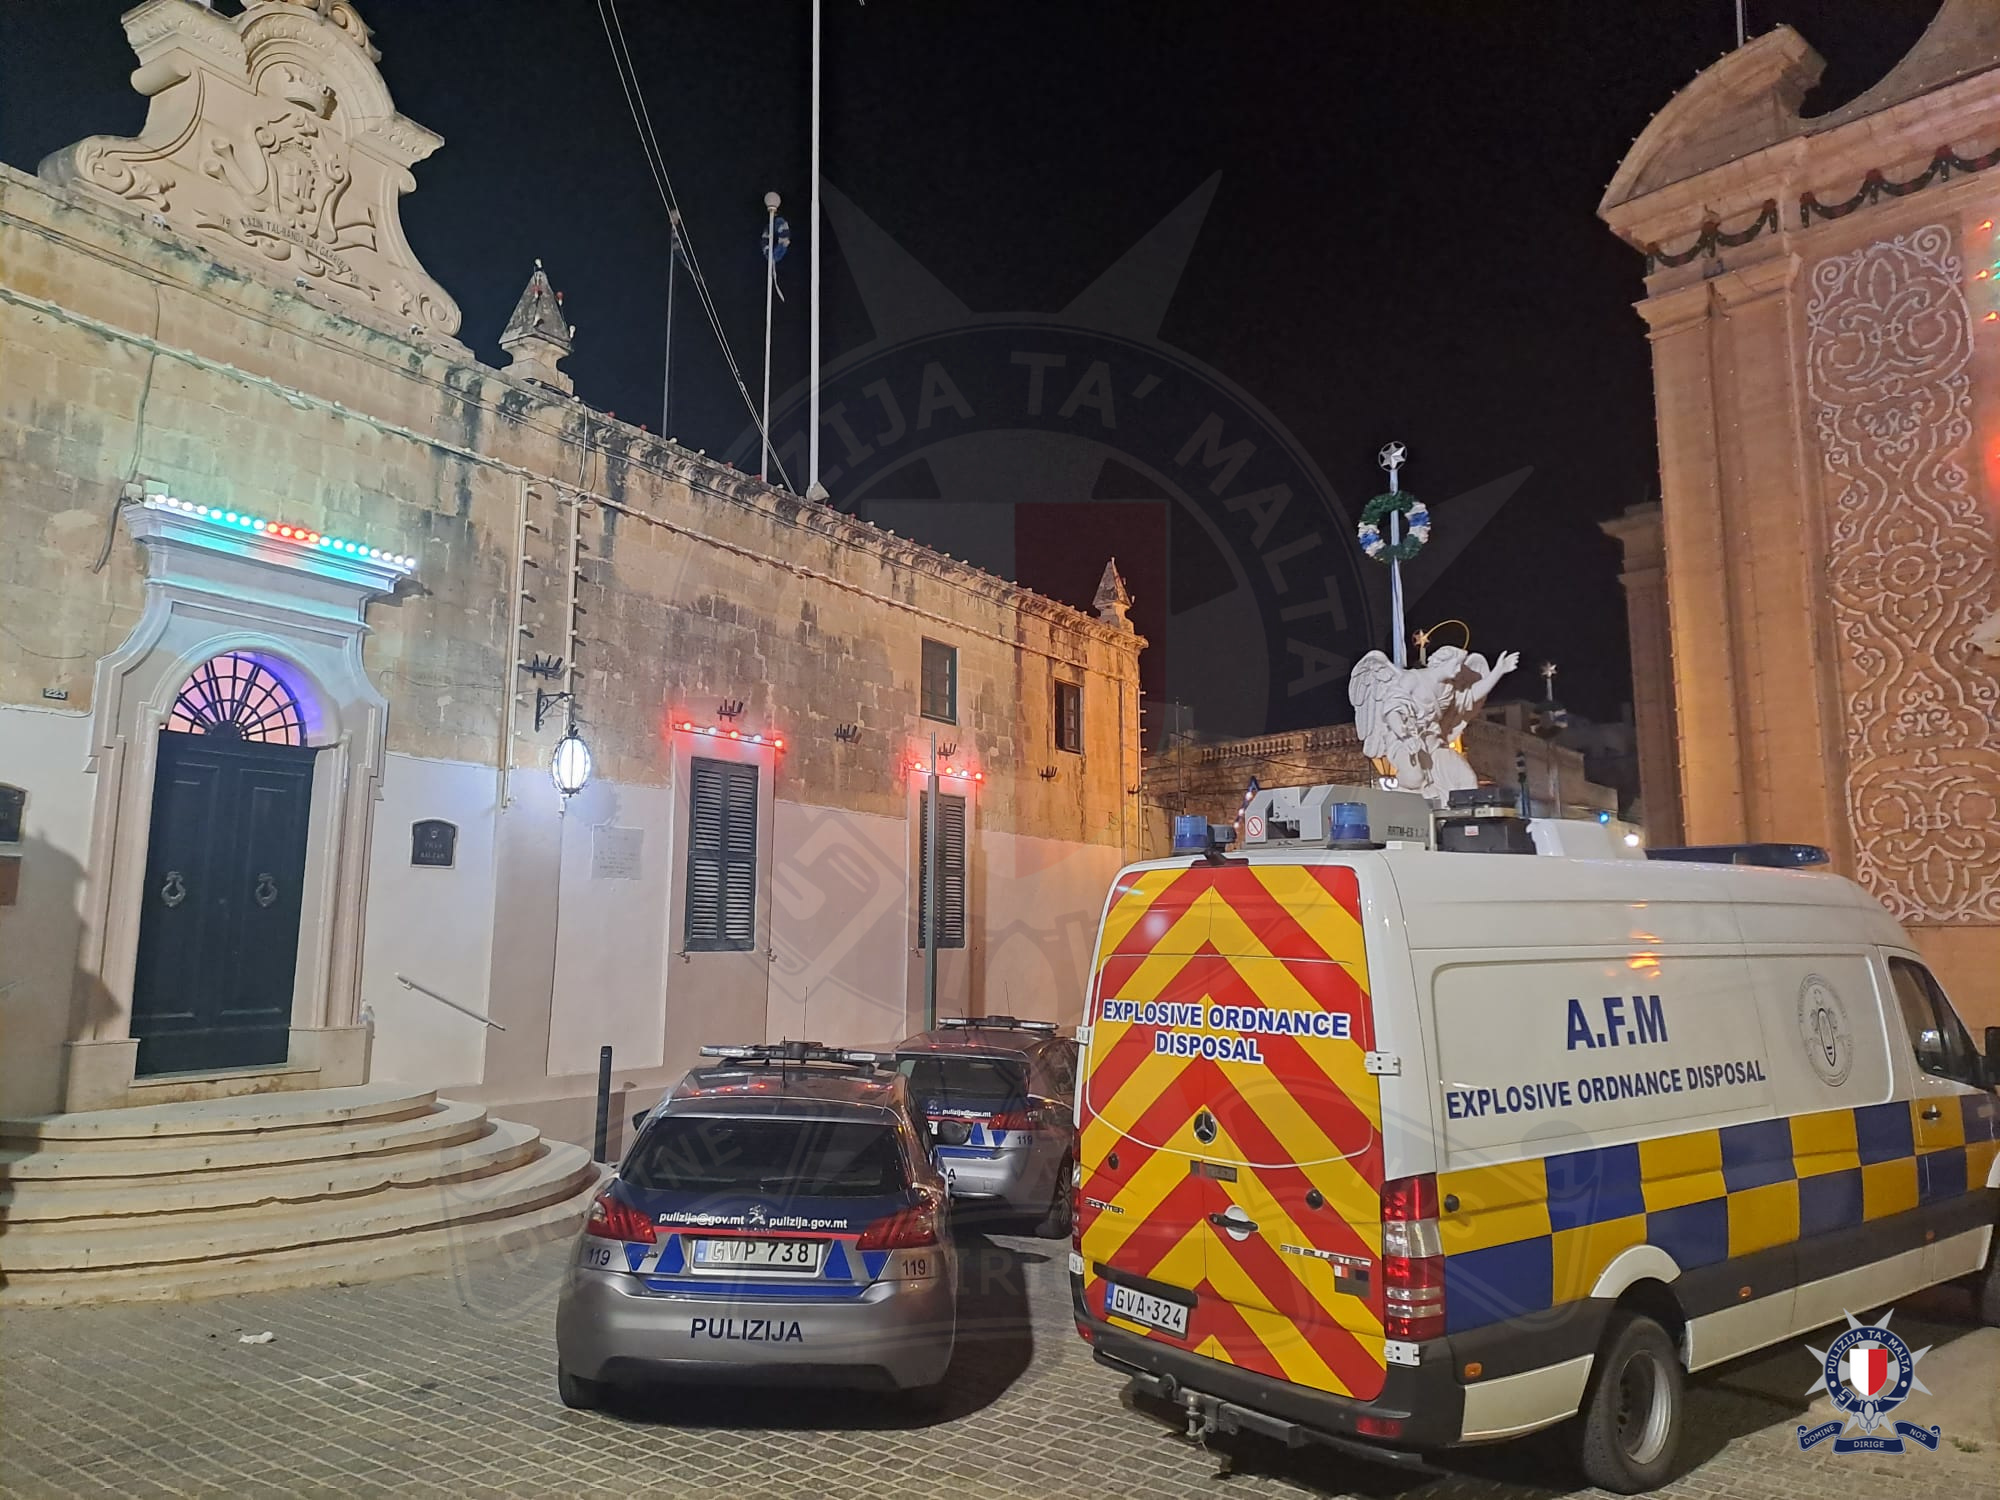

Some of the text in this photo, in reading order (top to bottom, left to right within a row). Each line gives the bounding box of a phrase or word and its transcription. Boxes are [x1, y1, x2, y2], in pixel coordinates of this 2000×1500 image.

[1102, 1000, 1351, 1038] EXPLOSIVE ORDNANCE
[1567, 995, 1668, 1050] A.F.M
[1155, 1032, 1263, 1063] DISPOSAL
[1446, 1059, 1766, 1120] EXPLOSIVE ORDNANCE DISPOSAL
[1017, 1135, 1033, 1145] 119
[769, 1216, 848, 1230] pulizija.gov.mt
[588, 1248, 611, 1266] 119
[711, 1240, 809, 1264] GVP 738
[902, 1259, 926, 1276] 119
[690, 1317, 804, 1343] PULIZIJA
